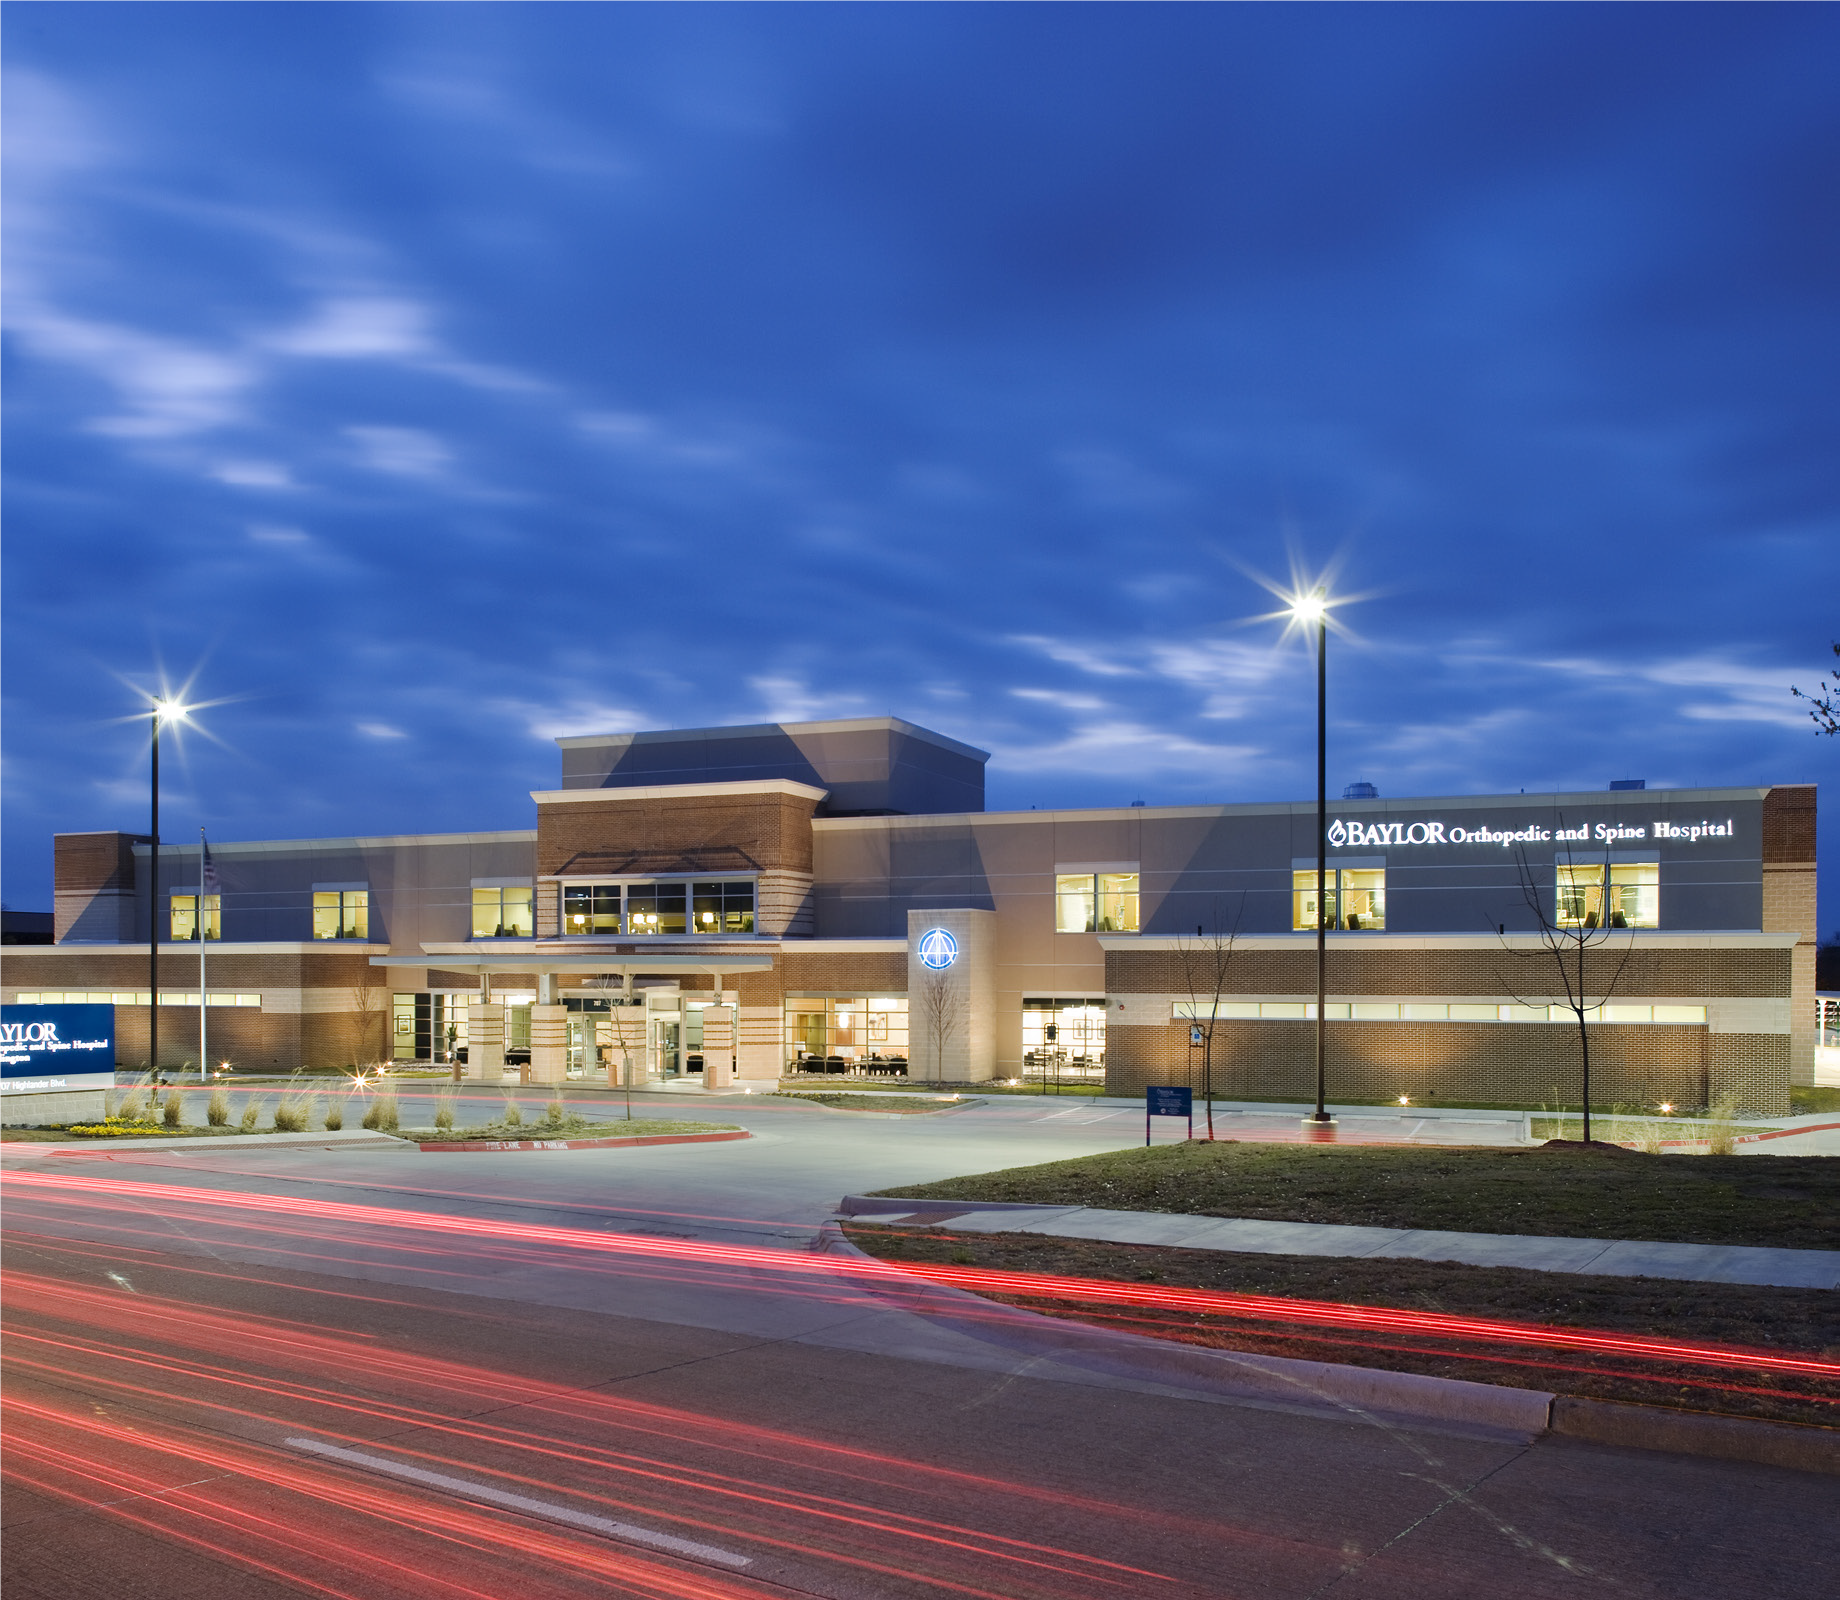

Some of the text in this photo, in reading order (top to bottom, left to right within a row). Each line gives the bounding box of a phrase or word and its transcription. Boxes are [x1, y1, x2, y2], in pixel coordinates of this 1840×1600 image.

[1346, 819, 1734, 847] BAYLOR Orthopedic and Spine Hospital
[29, 1041, 46, 1051] and
[47, 1041, 71, 1052] Spine
[73, 1039, 108, 1051] Hospital
[12, 1080, 49, 1091] Highlander
[50, 1079, 67, 1088] Blvd.
[503, 1141, 520, 1149] LANE
[533, 1140, 542, 1149] NO
[543, 1140, 568, 1149] PARKING
